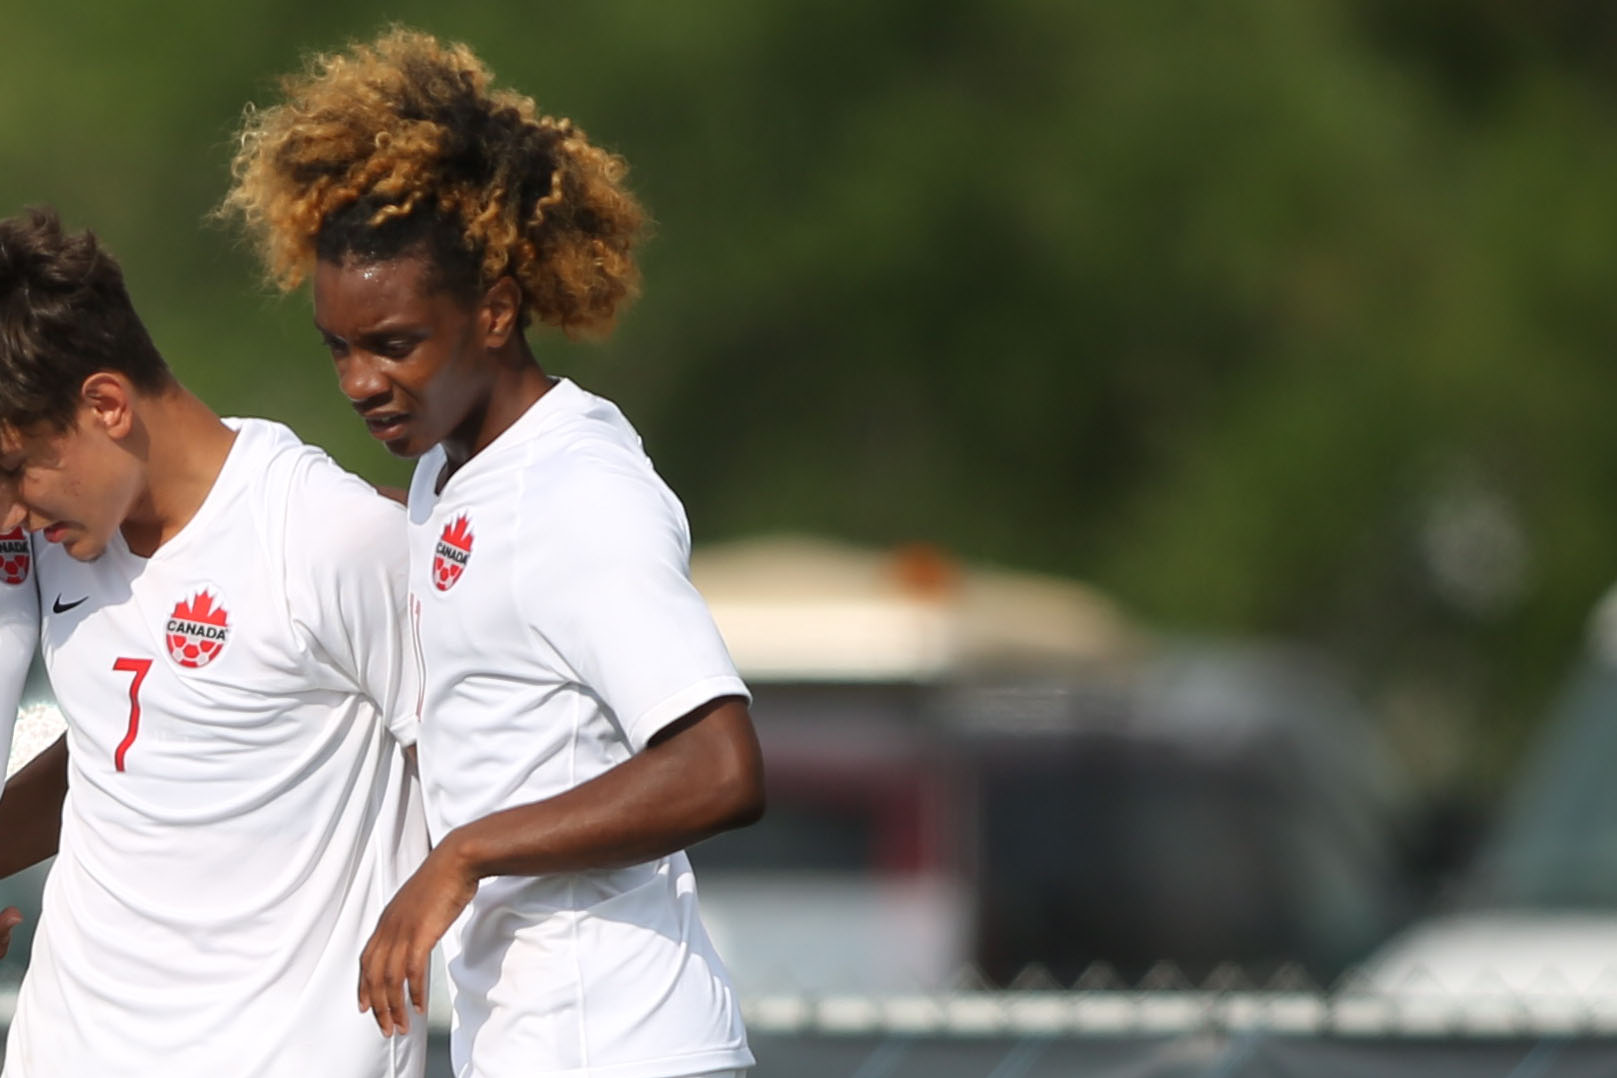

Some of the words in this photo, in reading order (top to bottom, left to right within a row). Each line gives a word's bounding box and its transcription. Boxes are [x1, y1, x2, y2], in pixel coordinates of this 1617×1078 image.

[436, 541, 471, 565] CANADA
[166, 618, 226, 641] CANADA
[112, 657, 154, 773] 7
